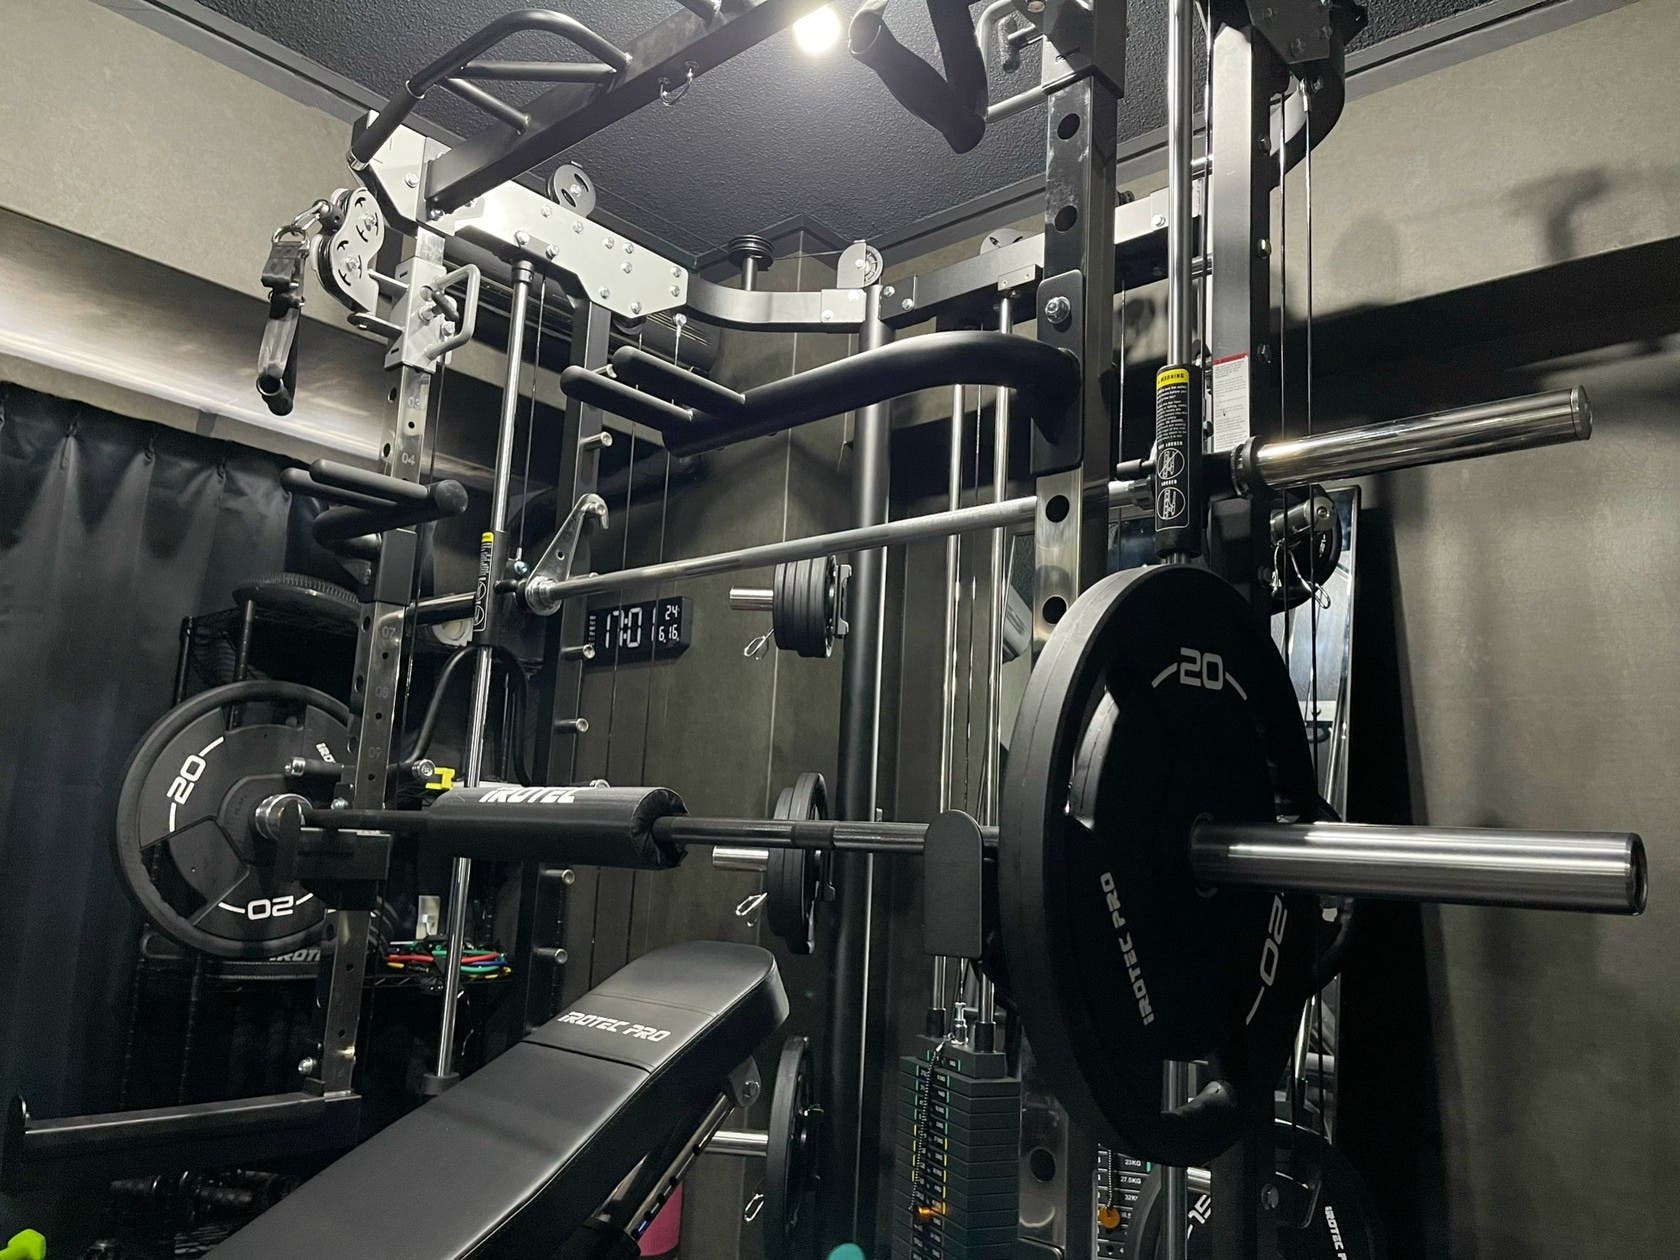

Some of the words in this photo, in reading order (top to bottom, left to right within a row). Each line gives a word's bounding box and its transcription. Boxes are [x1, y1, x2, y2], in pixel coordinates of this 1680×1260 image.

[401, 452, 416, 466] 04
[605, 607, 657, 648] 17:01
[1179, 647, 1224, 690] 20
[166, 754, 206, 805] 20
[247, 895, 294, 920] 20
[1100, 872, 1127, 929] PRO
[1260, 895, 1288, 986] 20
[1118, 931, 1155, 1026] IROTEC
[557, 1011, 631, 1033] IROTEC
[622, 1024, 672, 1042] PRO
[1188, 1194, 1212, 1225] 15
[1324, 1206, 1346, 1251] IROTEC
